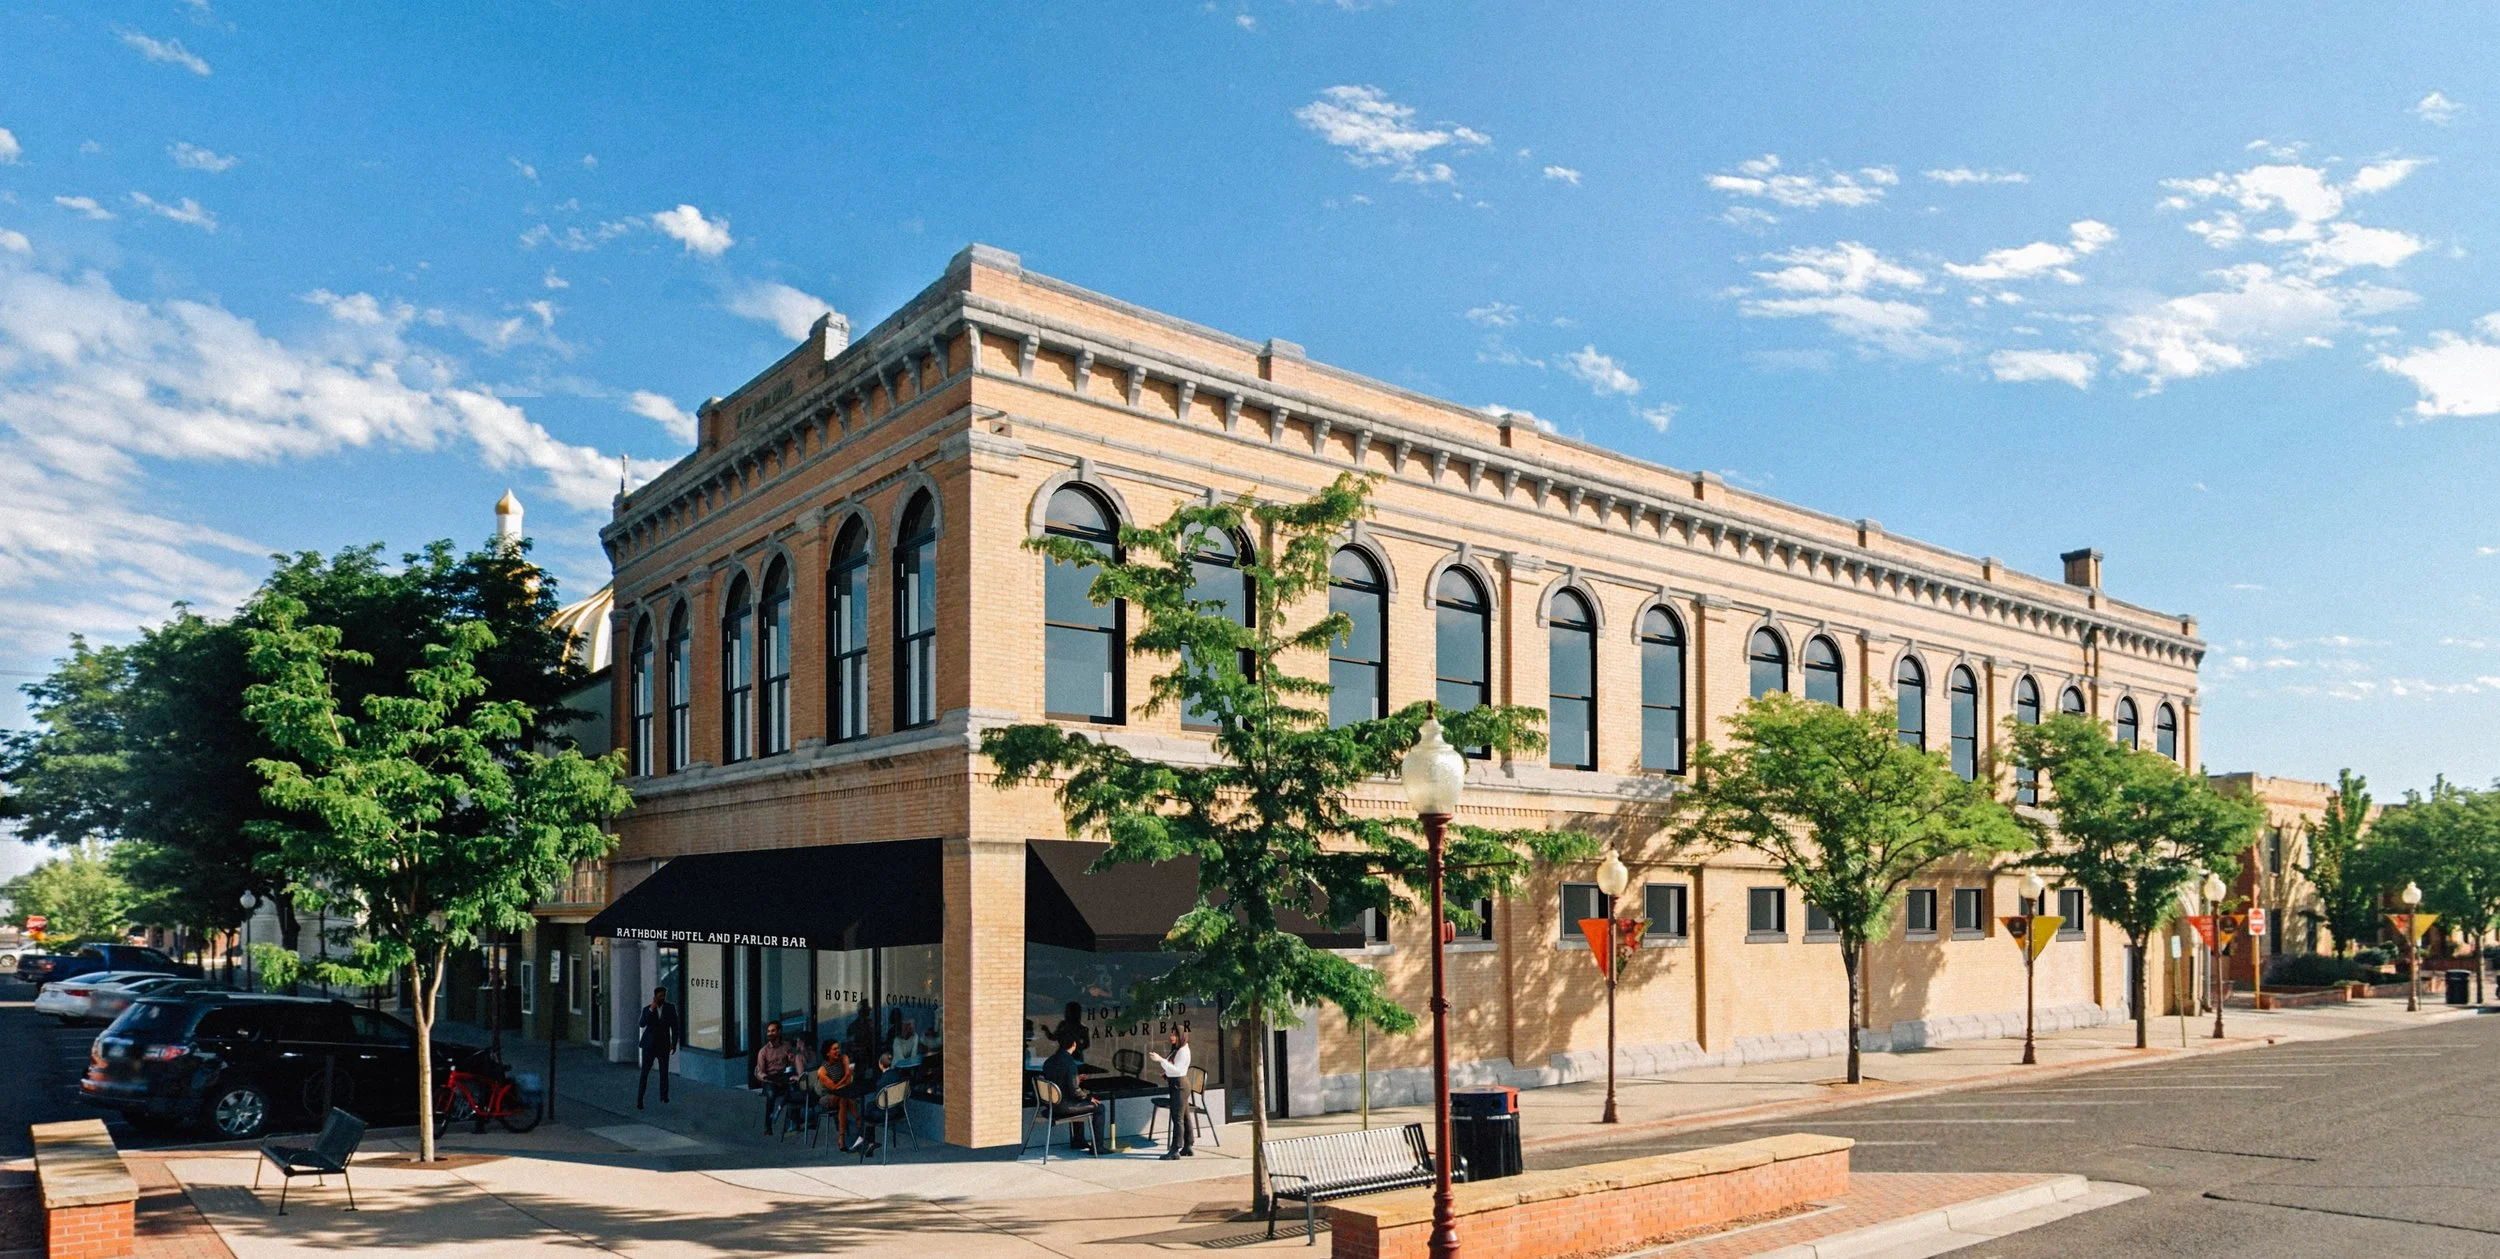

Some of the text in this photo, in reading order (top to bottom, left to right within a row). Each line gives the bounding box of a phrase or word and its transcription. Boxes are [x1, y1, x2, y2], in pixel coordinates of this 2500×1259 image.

[616, 927, 807, 948] RATHBONE HOTEL AND PARLOR BAR
[690, 977, 719, 989] COFFEE
[1087, 1005, 1142, 1021] HOT
